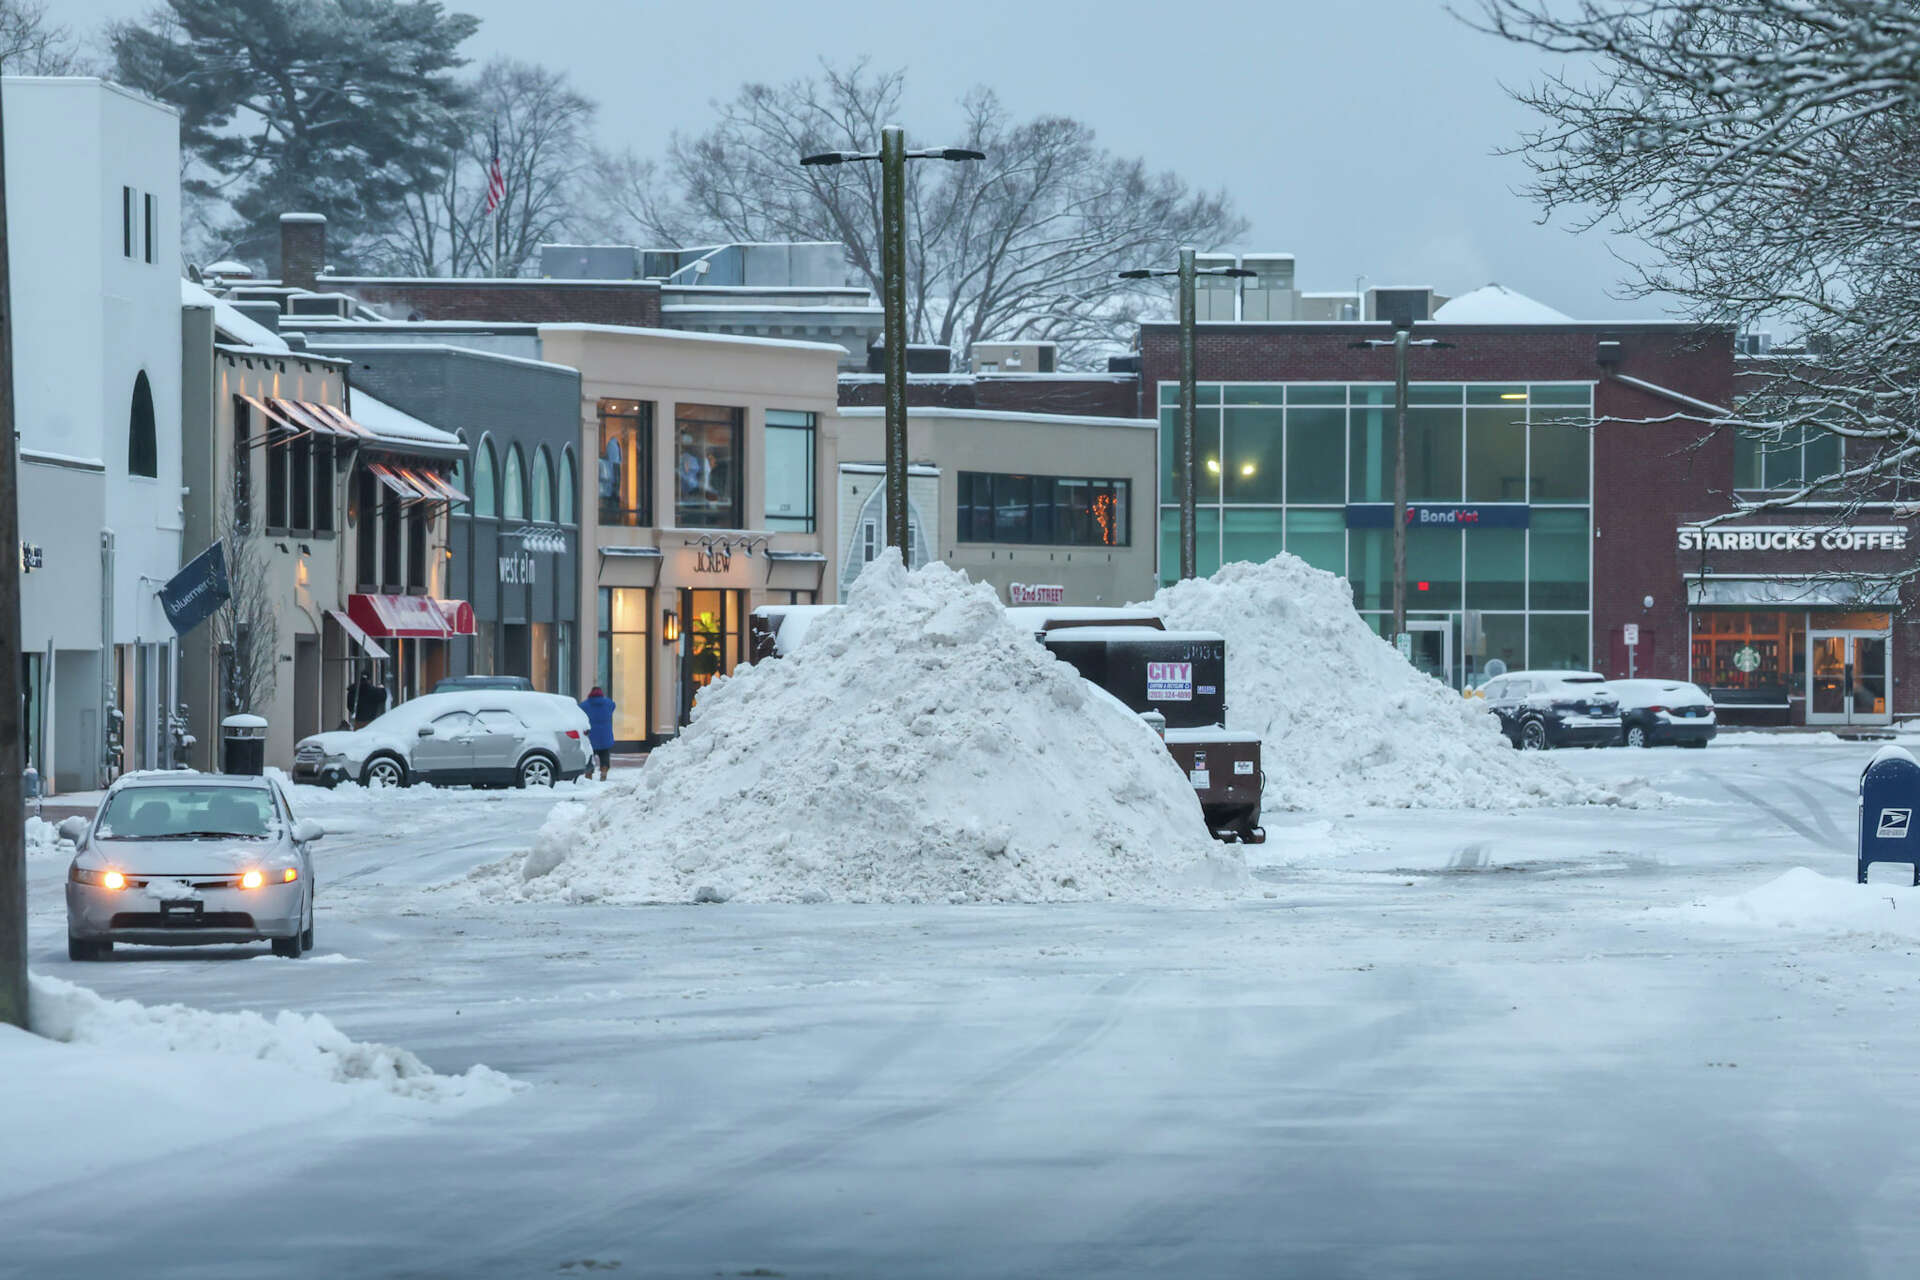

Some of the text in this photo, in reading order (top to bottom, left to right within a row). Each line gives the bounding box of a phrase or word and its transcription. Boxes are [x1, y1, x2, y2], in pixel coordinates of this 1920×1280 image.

[1678, 531, 1907, 550] STARBUCKS COFFEE
[499, 551, 536, 584] west elm
[1021, 586, 1036, 601] 2nd
[1037, 587, 1064, 602] STREET
[1148, 663, 1190, 680] CITY
